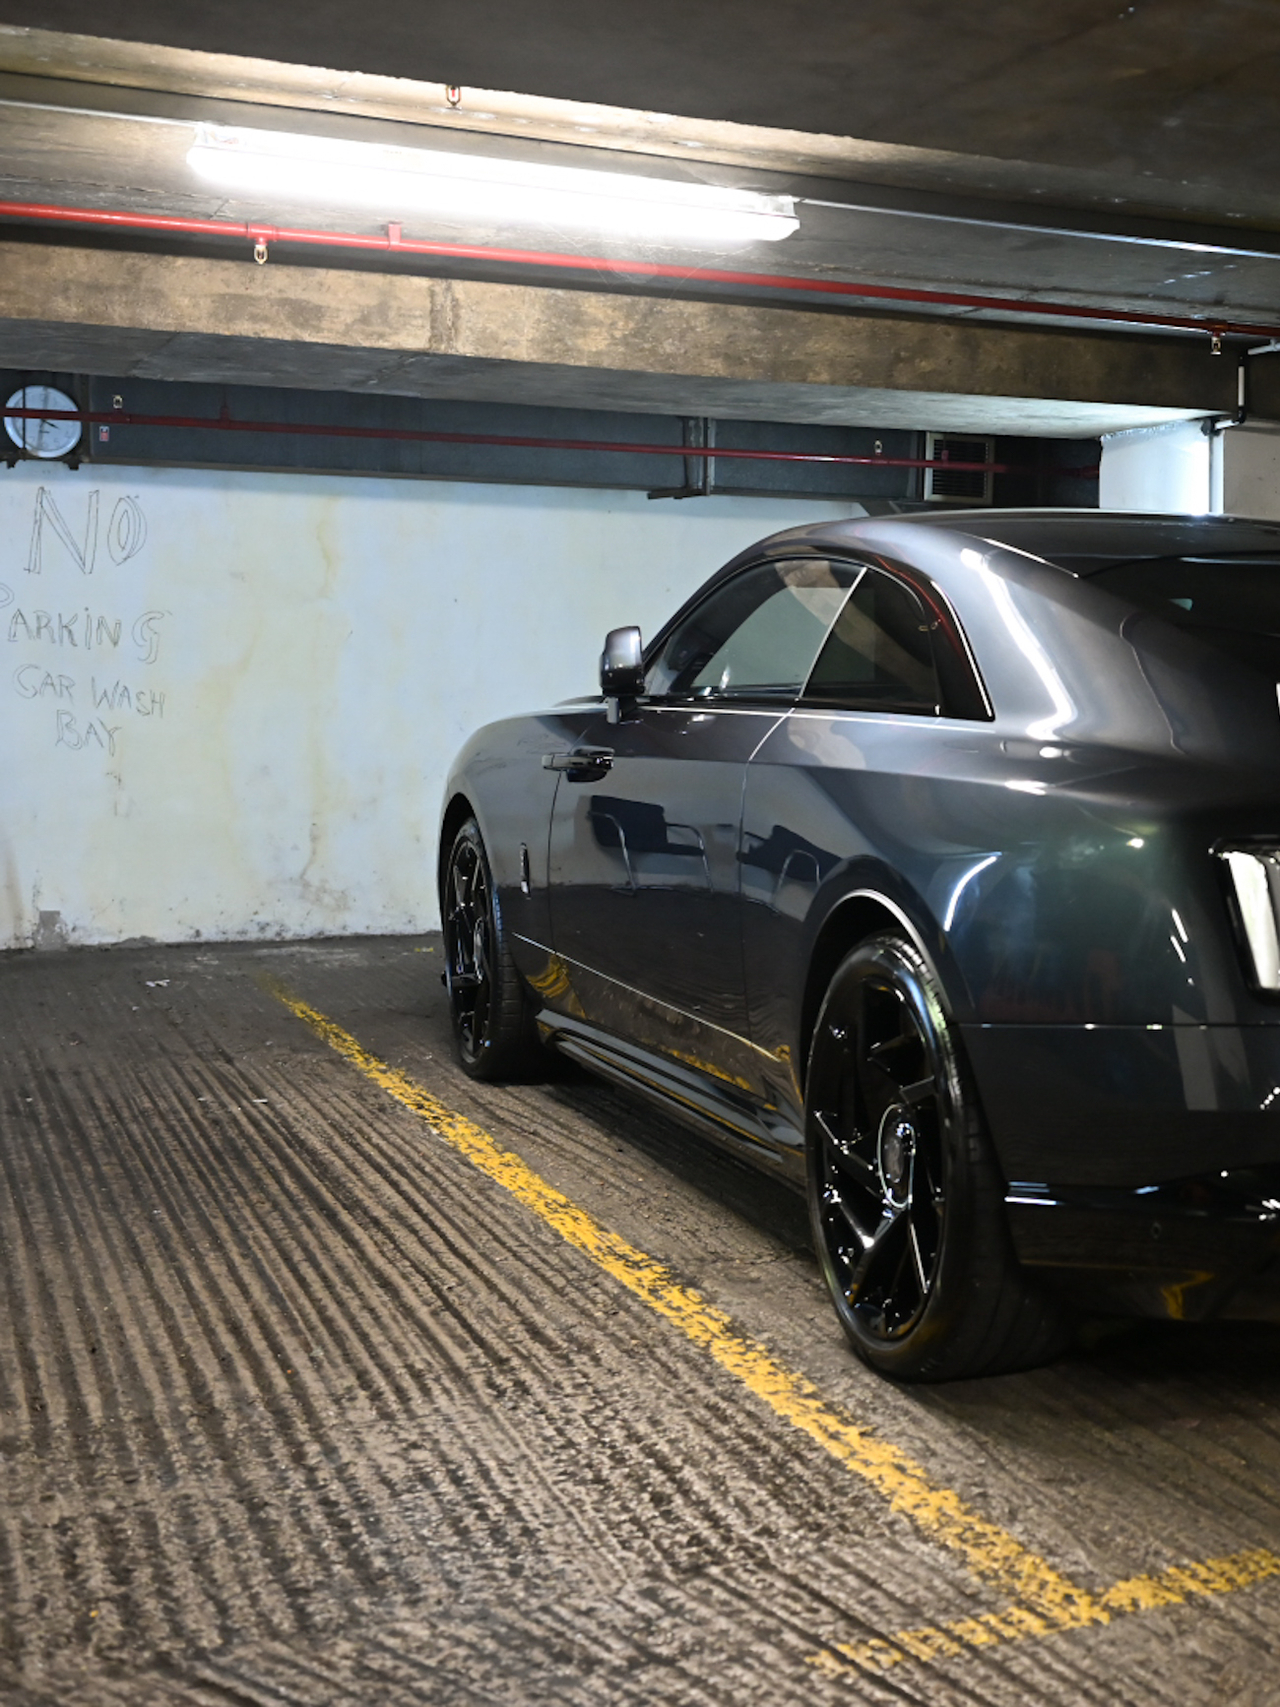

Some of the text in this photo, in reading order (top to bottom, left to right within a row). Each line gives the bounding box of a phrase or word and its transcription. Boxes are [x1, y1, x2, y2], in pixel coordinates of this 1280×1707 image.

[24, 486, 148, 575] NO
[91, 676, 166, 718] WASH
[55, 709, 123, 758] BAY
